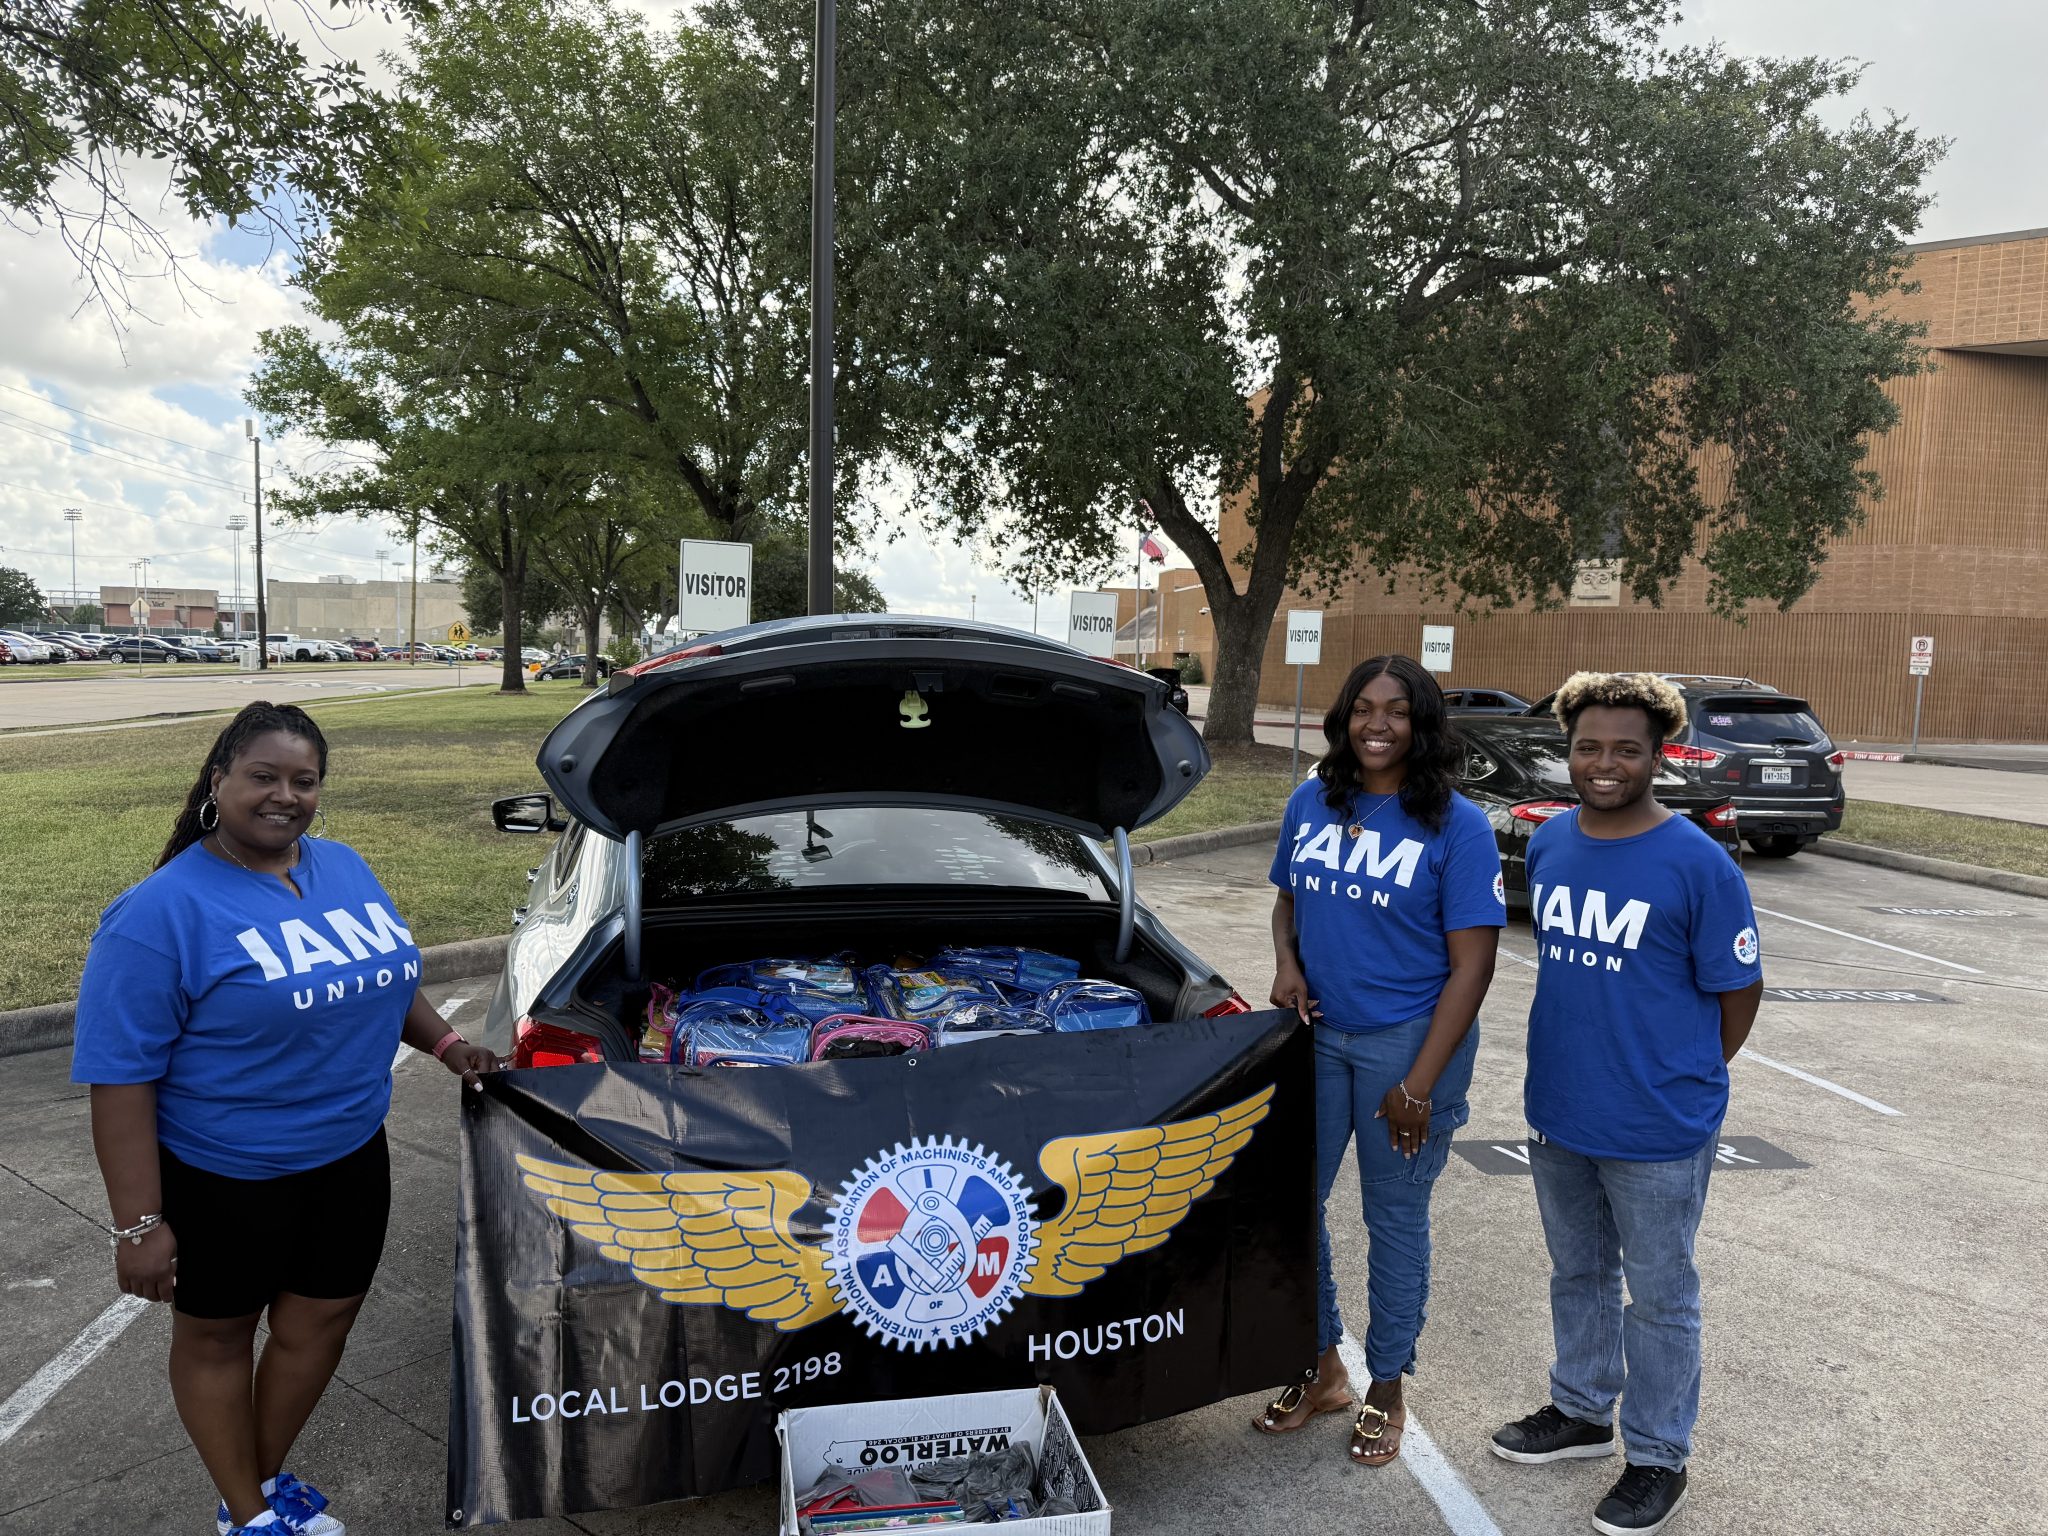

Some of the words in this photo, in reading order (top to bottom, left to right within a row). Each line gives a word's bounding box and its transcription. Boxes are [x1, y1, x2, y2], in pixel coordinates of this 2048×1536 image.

[685, 573, 746, 598] VISITOR
[1072, 614, 1113, 633] VISITOR
[1289, 629, 1319, 643] VISITOR
[1424, 641, 1451, 654] VISITOR
[1291, 822, 1425, 889] IAM
[1289, 872, 1390, 908] UNION
[235, 902, 415, 982] IAM
[292, 960, 419, 1010] UNION
[1763, 989, 1934, 1002] VISITOR
[880, 1157, 898, 1173] OF
[900, 1148, 988, 1170] MACHINISTS
[986, 1168, 1014, 1192] AND
[837, 1170, 881, 1258] ASSOCIATION
[1009, 1191, 1030, 1285] AEROSPACE
[871, 1263, 895, 1289] A
[977, 1251, 1001, 1277] M
[840, 1261, 923, 1340] INTERNATIONAL
[929, 1300, 945, 1310] OF
[950, 1284, 1015, 1337] WORKERS
[1028, 1308, 1184, 1362] HOUSTON
[512, 1386, 629, 1423] LOCAL
[640, 1371, 762, 1411] LODGE
[772, 1351, 843, 1393] 2198
[860, 1434, 1010, 1466] WATERLOO
